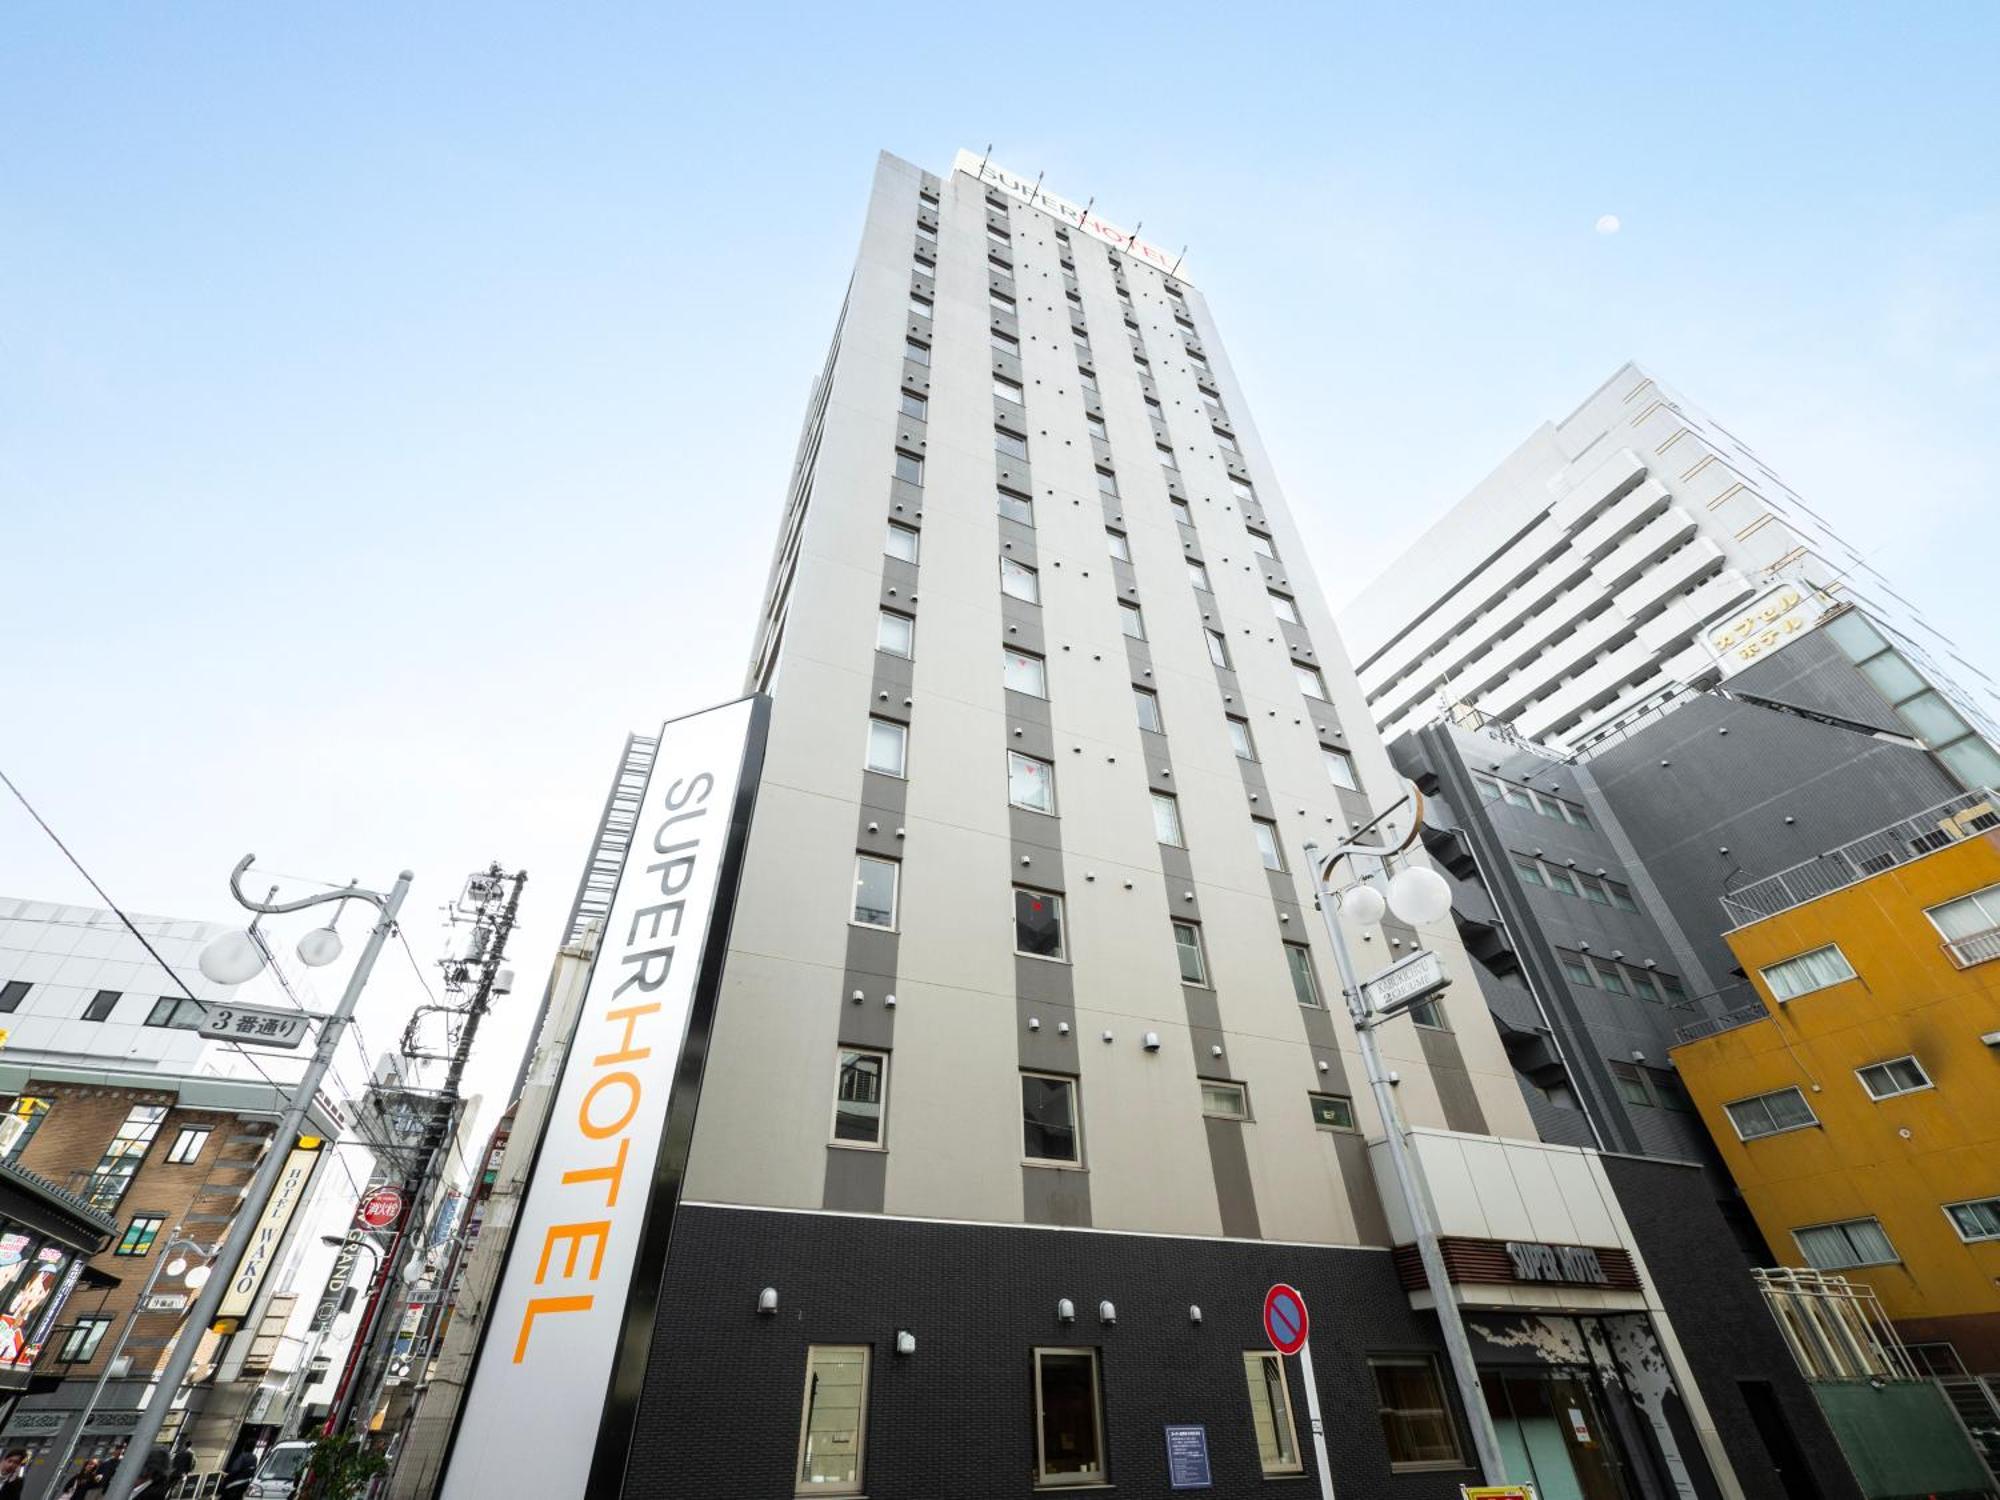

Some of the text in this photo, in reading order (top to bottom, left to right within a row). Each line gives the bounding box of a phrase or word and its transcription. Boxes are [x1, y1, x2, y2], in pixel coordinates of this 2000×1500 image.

[237, 1168, 301, 1294] HOTEL WAKO
[1506, 1242, 1609, 1284] SUPER HOTEL
